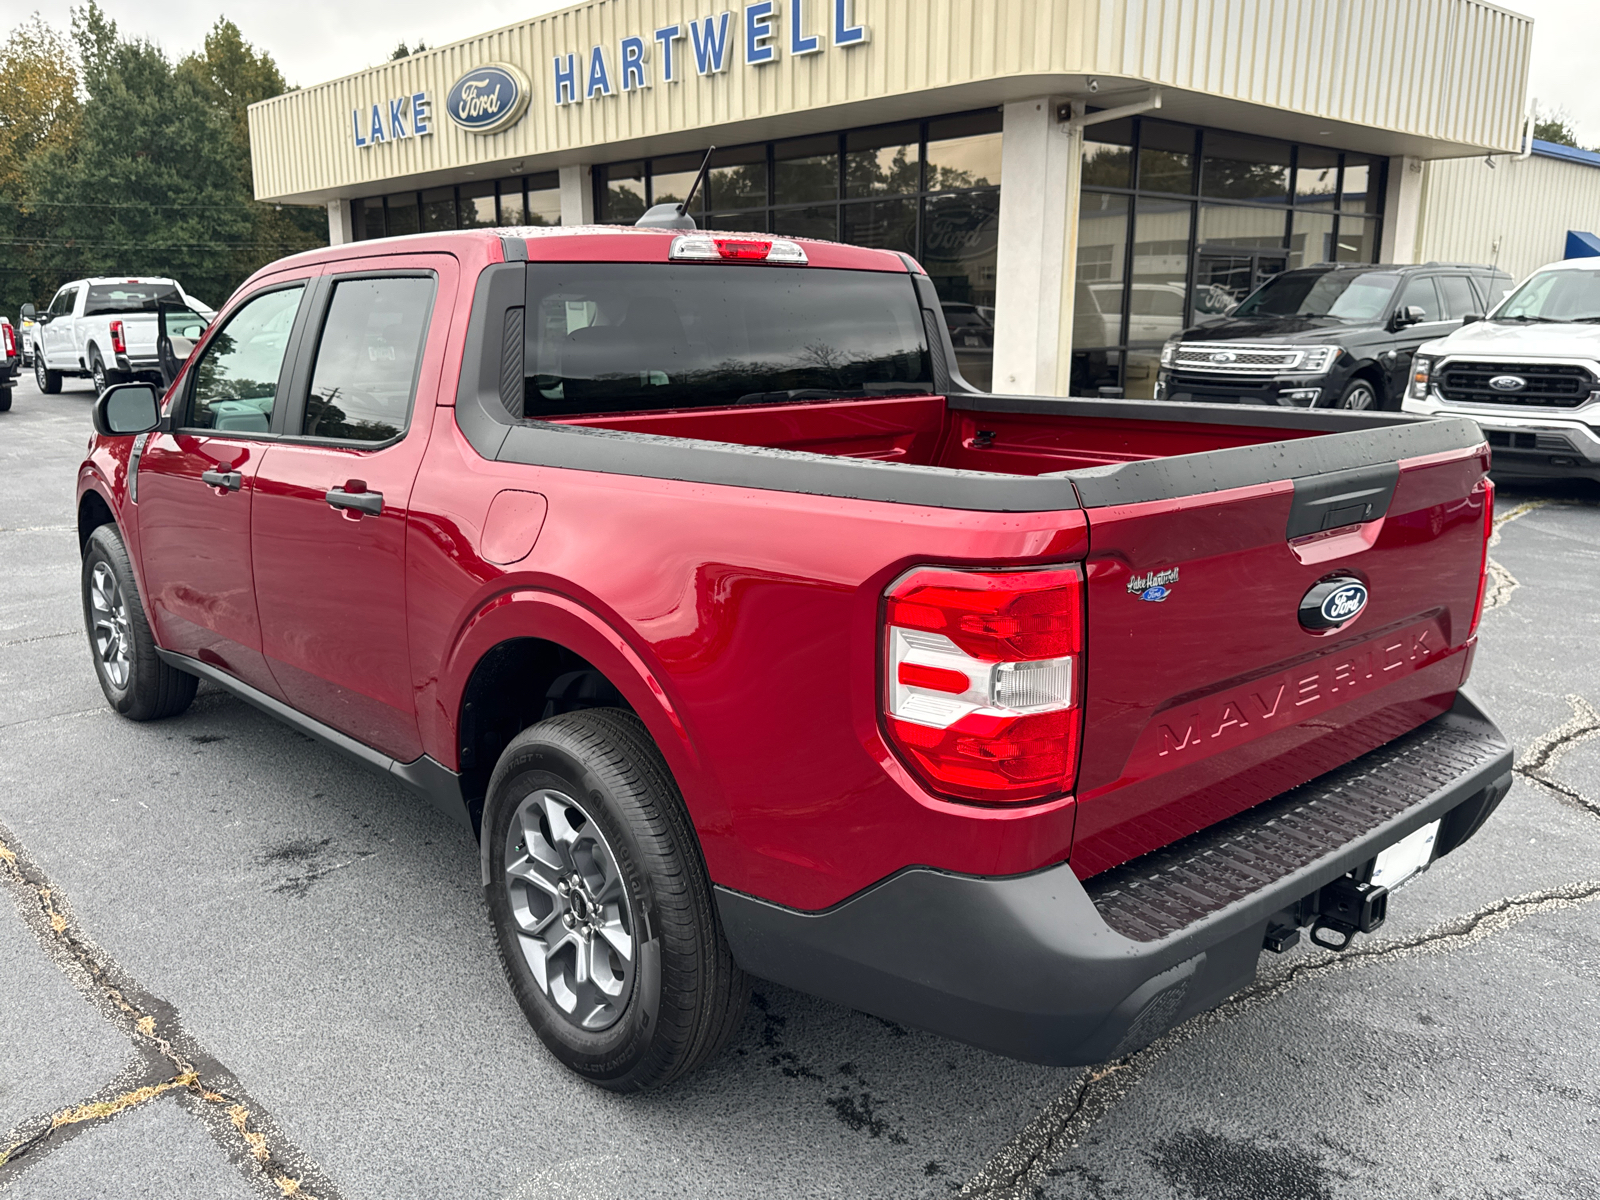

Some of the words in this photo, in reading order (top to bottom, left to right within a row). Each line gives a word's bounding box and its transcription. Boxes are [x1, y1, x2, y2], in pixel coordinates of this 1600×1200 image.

[353, 91, 431, 147] LAKE
[458, 78, 501, 119] Ford
[553, 0, 868, 106] HARTWELL
[926, 216, 982, 249] Ford
[1127, 575, 1147, 594] Lake
[1146, 566, 1180, 589] Hartwell
[1331, 589, 1361, 617] Ford
[1156, 630, 1431, 757] MAVERICK
[589, 789, 648, 901] Continental
